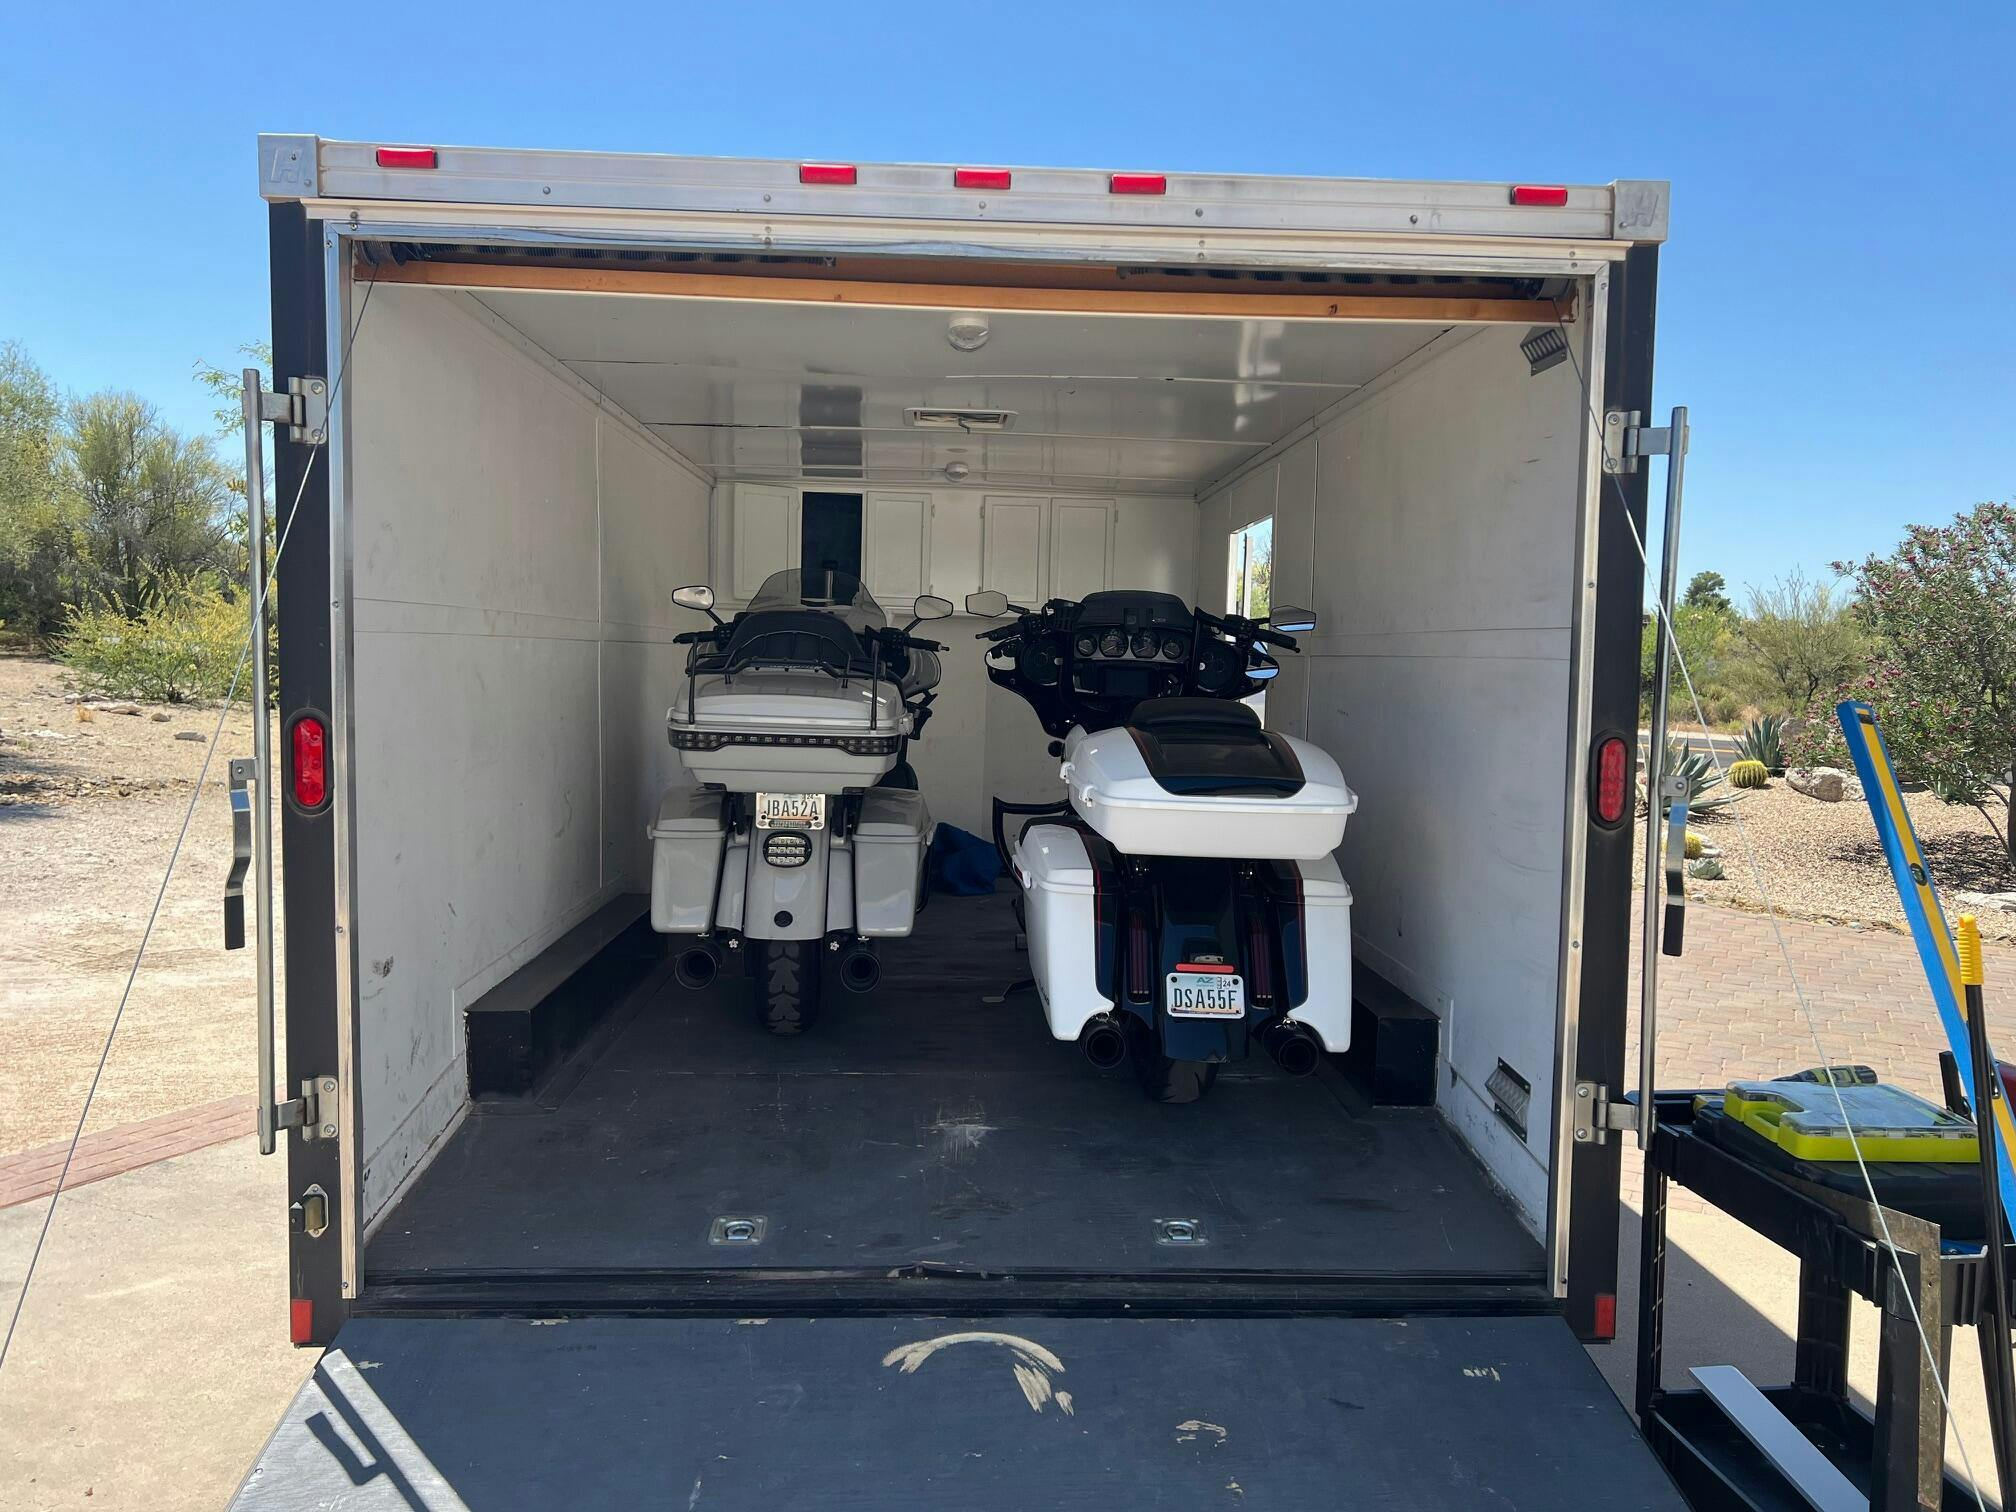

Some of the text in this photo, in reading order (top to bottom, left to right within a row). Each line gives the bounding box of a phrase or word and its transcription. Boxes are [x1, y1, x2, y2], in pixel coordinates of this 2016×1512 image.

[767, 799, 818, 817] JBA52A
[1196, 976, 1214, 984] AZ
[1222, 979, 1231, 988] 24
[1174, 988, 1237, 1010] DSA55F
